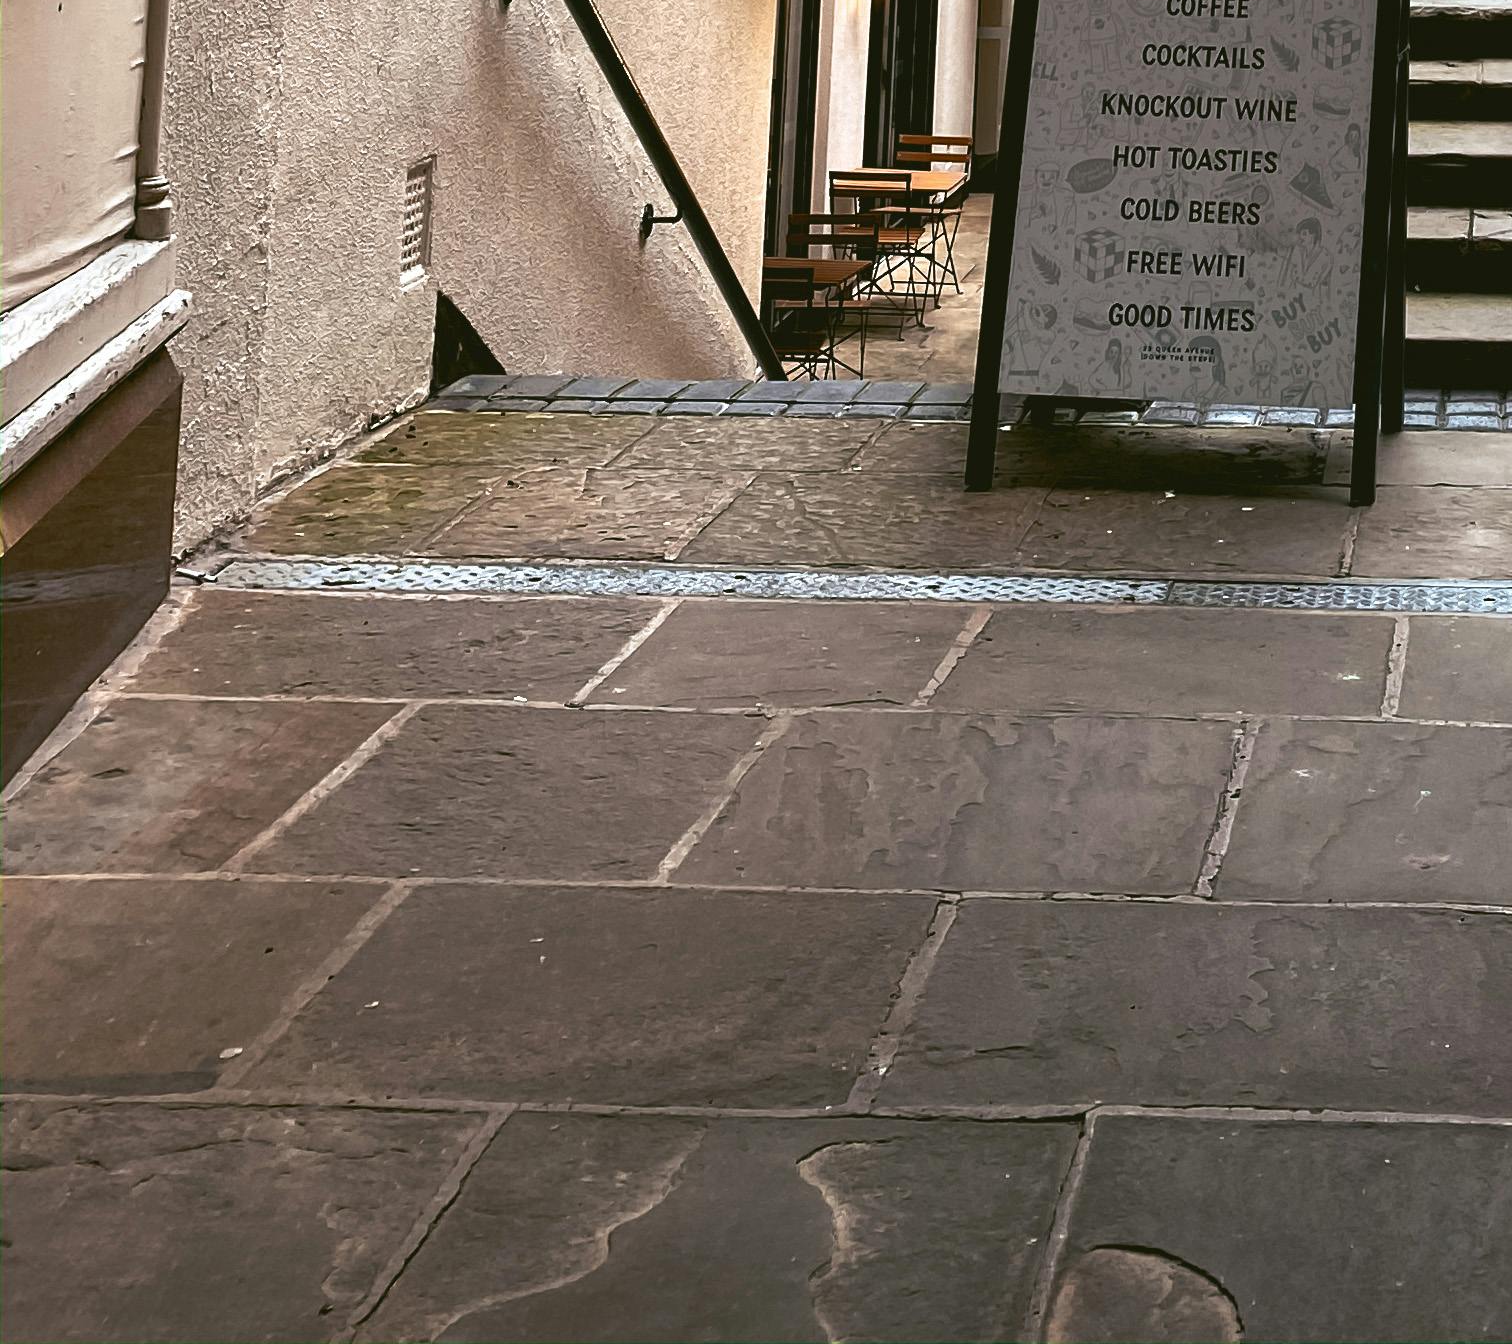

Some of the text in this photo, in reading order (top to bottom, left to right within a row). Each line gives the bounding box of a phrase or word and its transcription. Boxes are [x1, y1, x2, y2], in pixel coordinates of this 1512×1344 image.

[1142, 44, 1265, 70] COCKTAILS
[1101, 93, 1297, 122] KNOCKOUT WINE
[1113, 145, 1278, 173] HOT TOASTIES
[1120, 197, 1261, 225] COLD BEERS
[1127, 250, 1245, 278] FREE WIFI
[1108, 302, 1255, 332] GOOD TIMES
[1272, 293, 1306, 328] BUY
[1307, 318, 1341, 353] BUY
